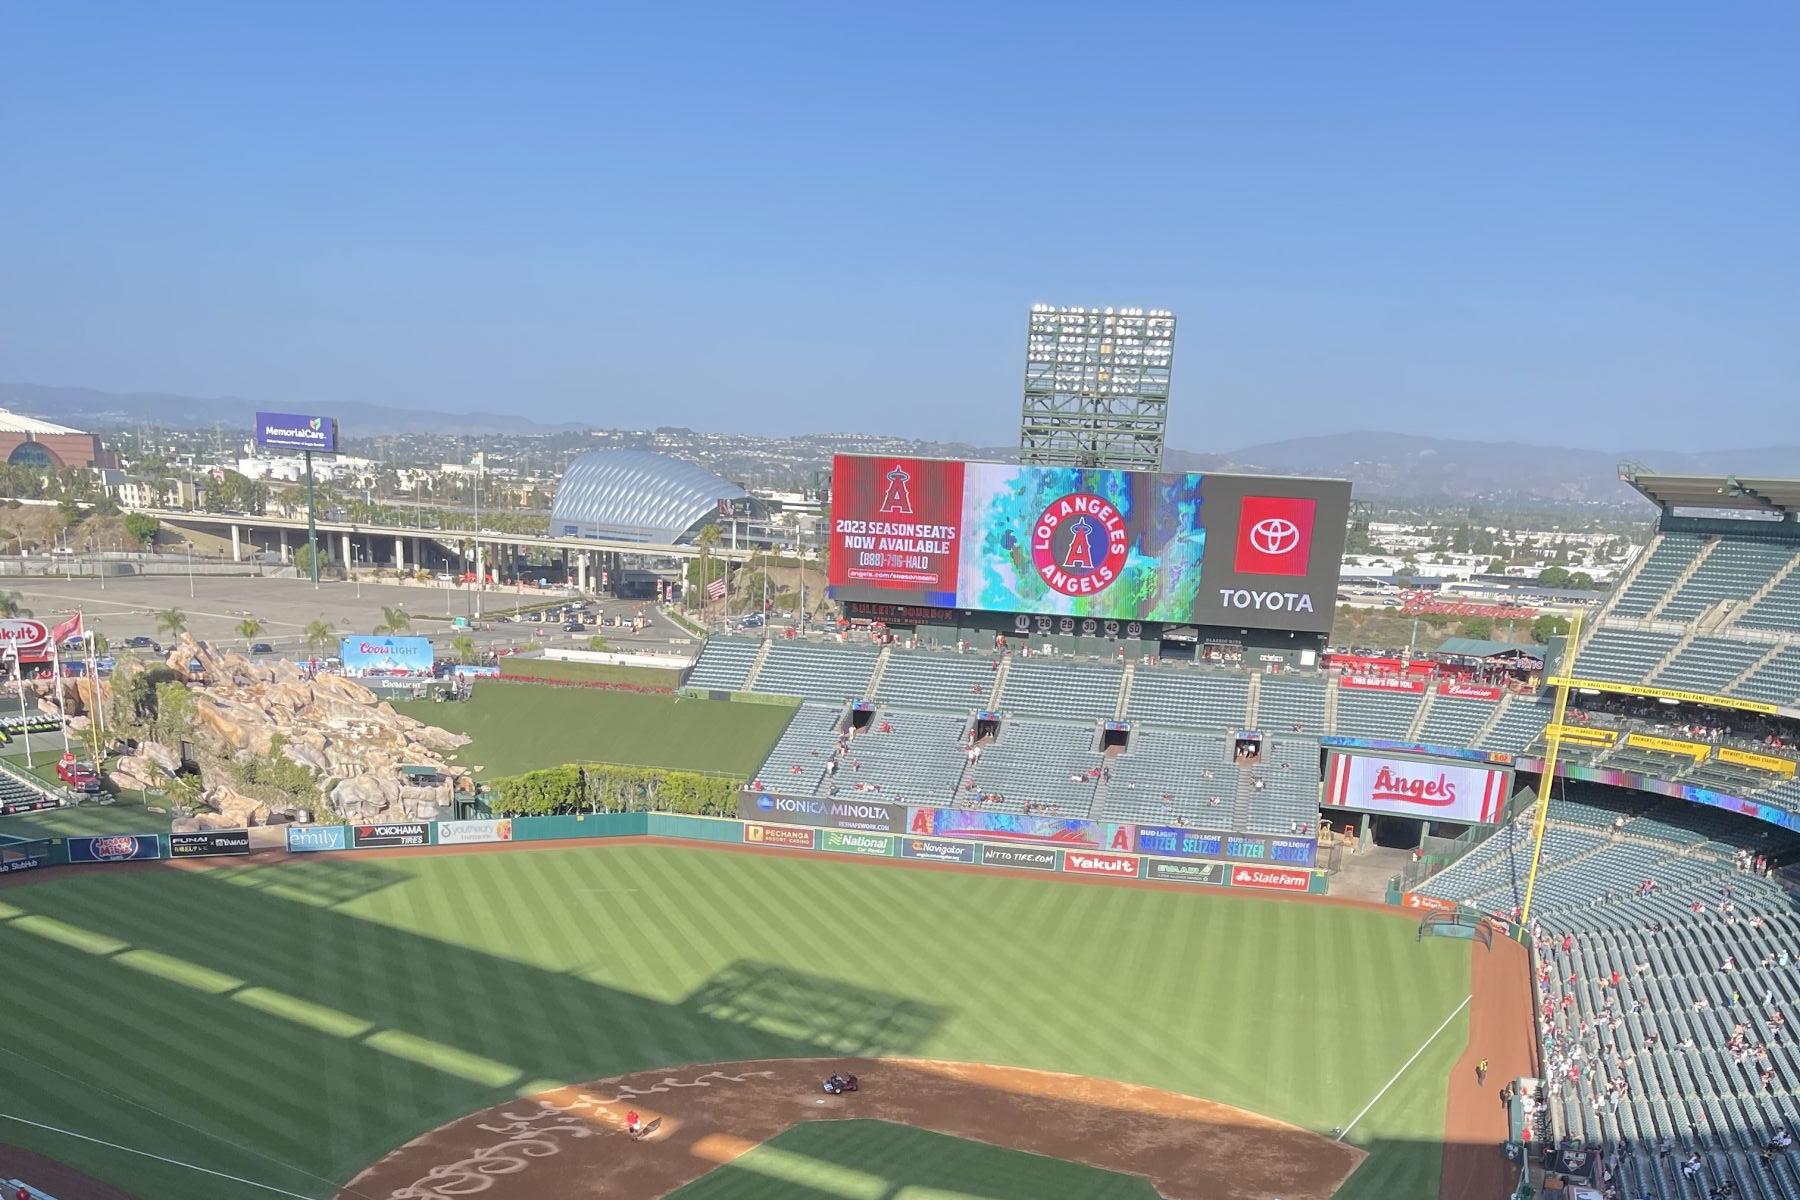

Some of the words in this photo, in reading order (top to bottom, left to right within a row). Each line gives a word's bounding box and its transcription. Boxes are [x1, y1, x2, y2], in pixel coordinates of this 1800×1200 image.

[265, 426, 325, 439] MemorialCare
[836, 519, 866, 534] 2023
[868, 521, 916, 537] SEASON
[915, 524, 956, 540] SEATS
[1036, 513, 1058, 550] LOS
[1061, 497, 1125, 555] ANGELES
[844, 536, 876, 550] NOW
[878, 537, 950, 555] AVAILABLE
[1041, 564, 1114, 593] ANGELS
[1219, 588, 1315, 613] TOYOTA
[360, 641, 389, 655] Coors
[390, 645, 418, 655] LIGHT
[1448, 685, 1492, 698] Budweiser
[1374, 766, 1457, 801] Angels
[775, 798, 828, 815] KONICA
[830, 803, 890, 820] MINOLTA
[290, 828, 339, 848] emily
[374, 825, 424, 836] YOKOHAMA
[765, 829, 809, 840] PECHANGA
[1200, 834, 1222, 842] LIGHT
[400, 836, 423, 844] TIRES
[840, 833, 888, 849] National
[1139, 835, 1177, 851] SELTZER
[922, 842, 966, 856] Navigator
[984, 849, 1012, 861] NITTO
[1013, 852, 1054, 864] TIRE.COM
[1226, 841, 1265, 859] SELTZER
[1069, 855, 1134, 873] Yakult
